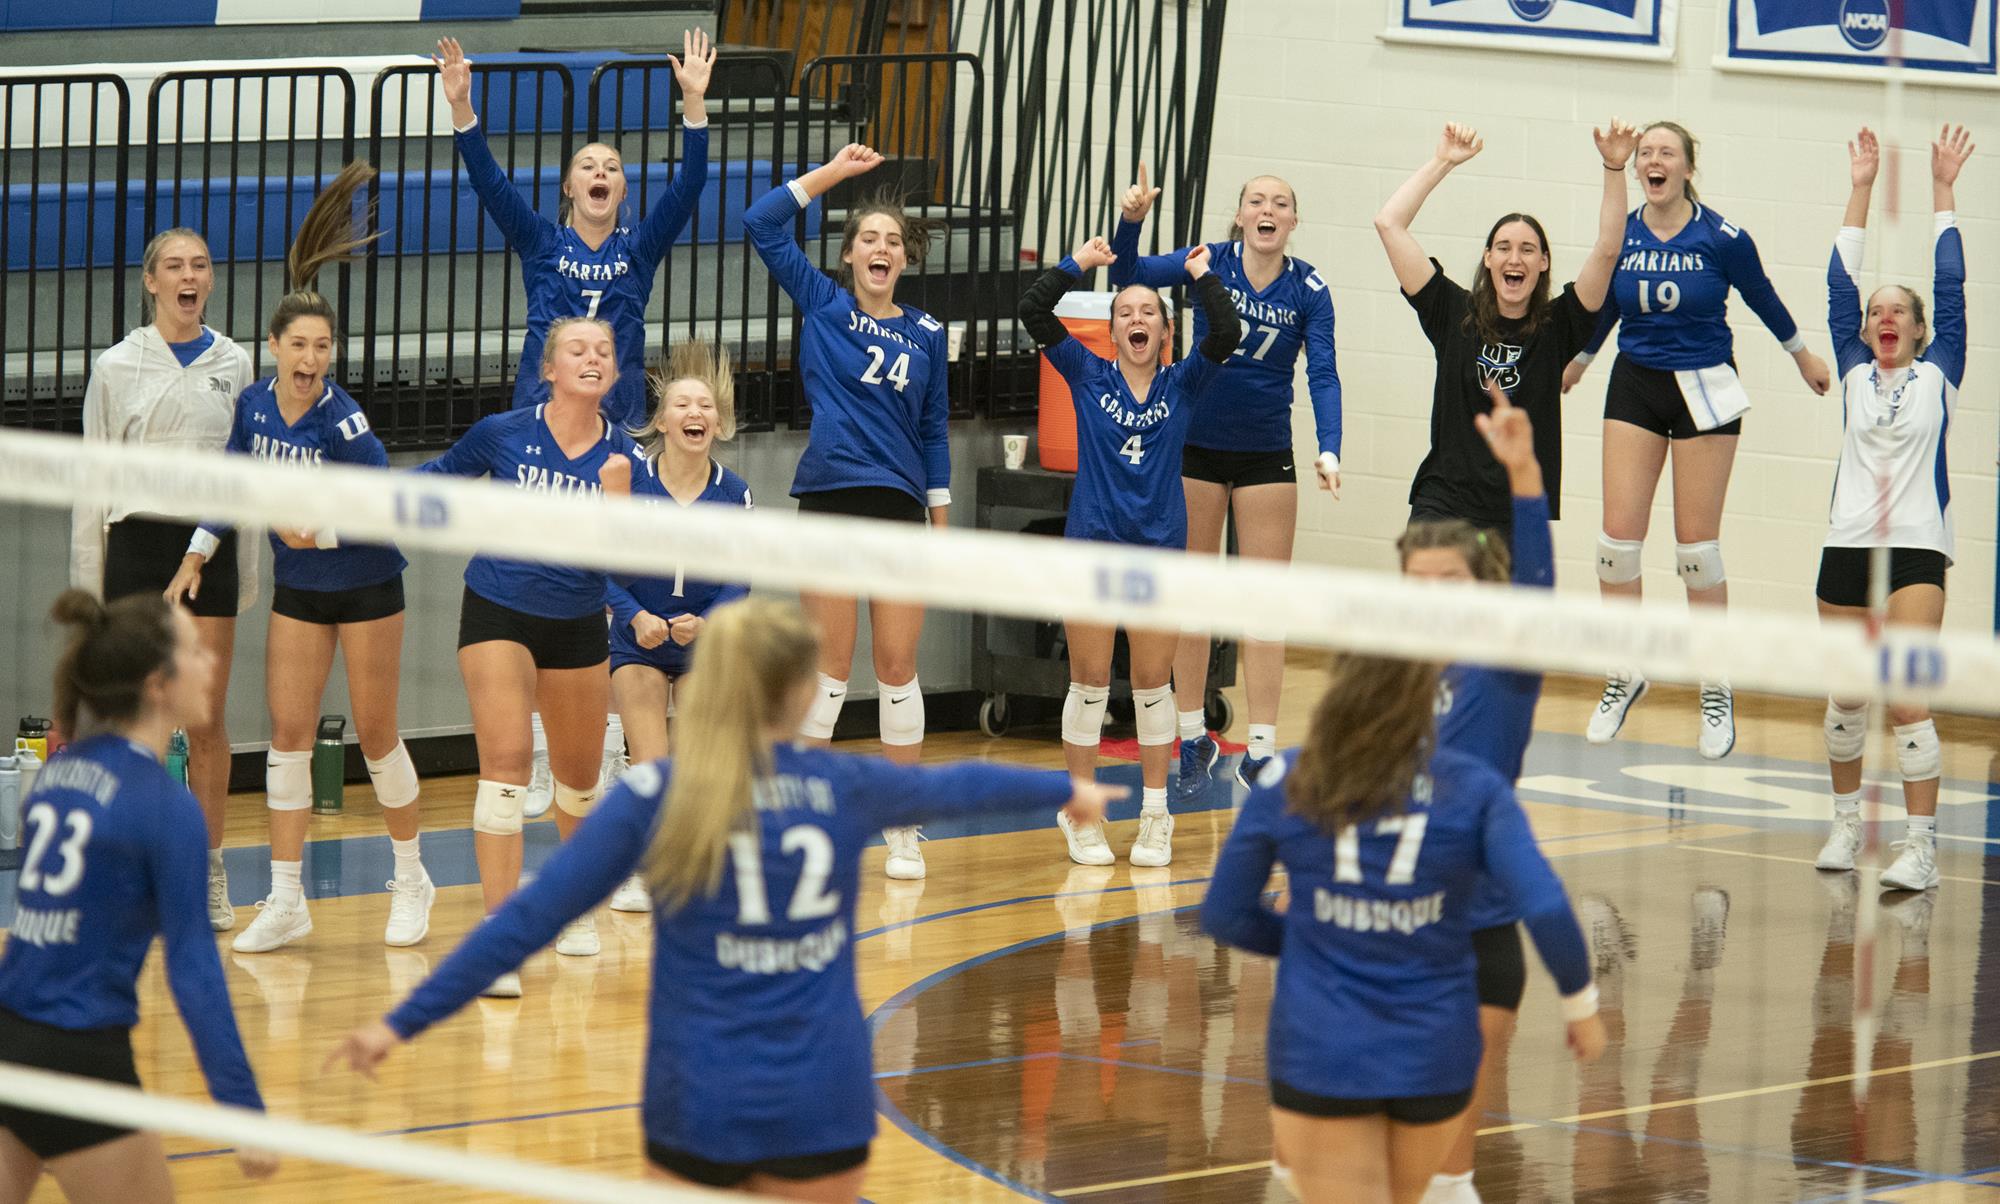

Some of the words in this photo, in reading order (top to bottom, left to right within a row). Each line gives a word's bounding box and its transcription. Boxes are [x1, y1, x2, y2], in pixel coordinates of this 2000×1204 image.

[1845, 12, 1888, 30] NCAA
[581, 289, 603, 320] 7
[1223, 285, 1297, 325] PARTANS
[1638, 279, 1681, 314] 19
[860, 345, 911, 393] 24
[1476, 361, 1521, 391] VB
[251, 432, 323, 470] PARTANS
[1119, 434, 1146, 465] 4
[515, 463, 608, 501] SPARTAN
[18, 802, 93, 897] 23
[1332, 812, 1429, 886] 17
[728, 823, 842, 926] 12
